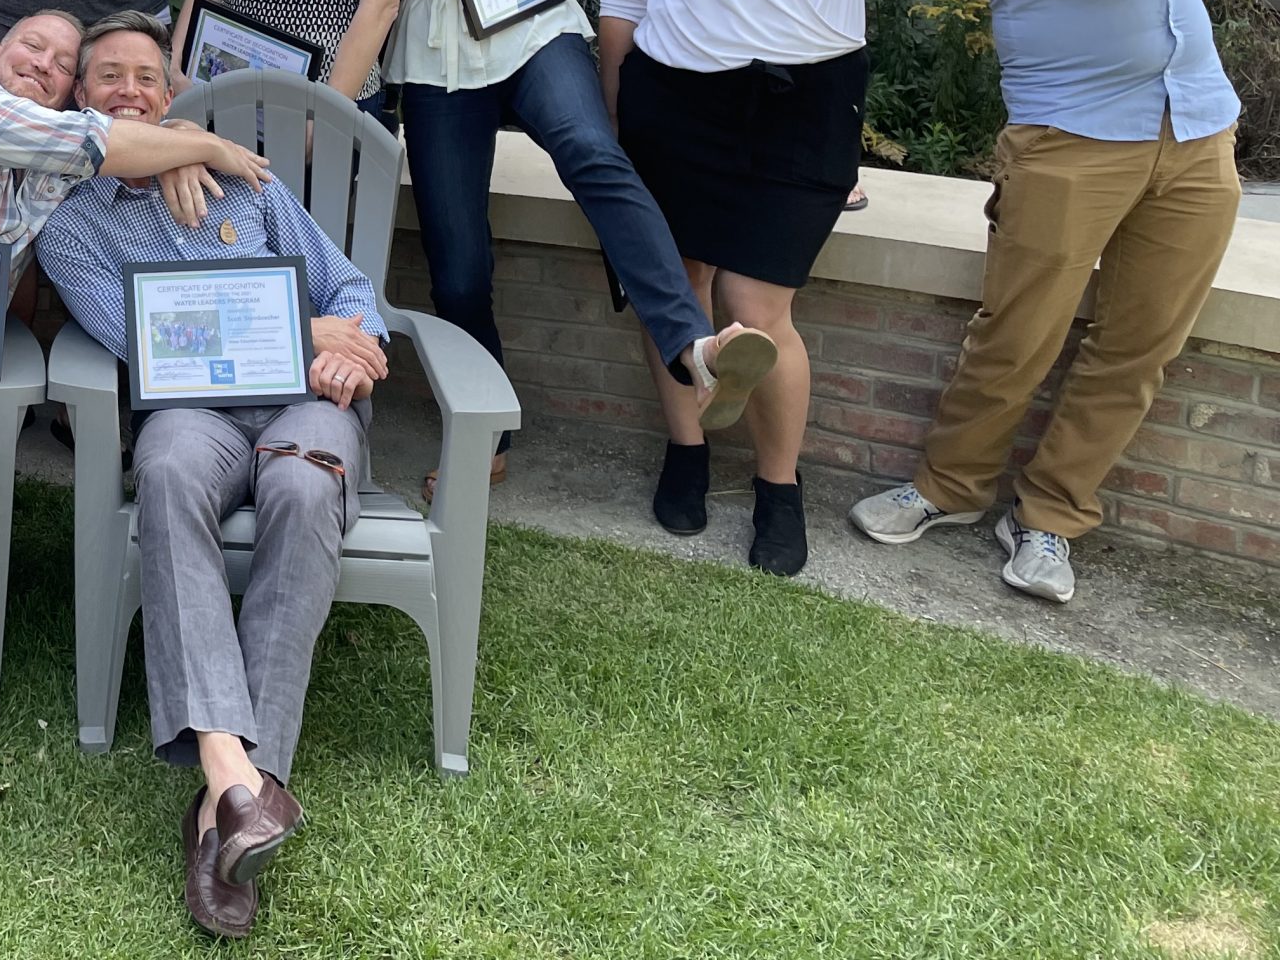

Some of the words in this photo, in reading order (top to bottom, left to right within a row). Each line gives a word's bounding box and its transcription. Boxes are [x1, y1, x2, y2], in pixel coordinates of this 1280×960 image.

[157, 284, 201, 293] CERTIFICATE
[215, 282, 266, 291] RECOGNITION
[227, 297, 260, 305] PROGRAM
